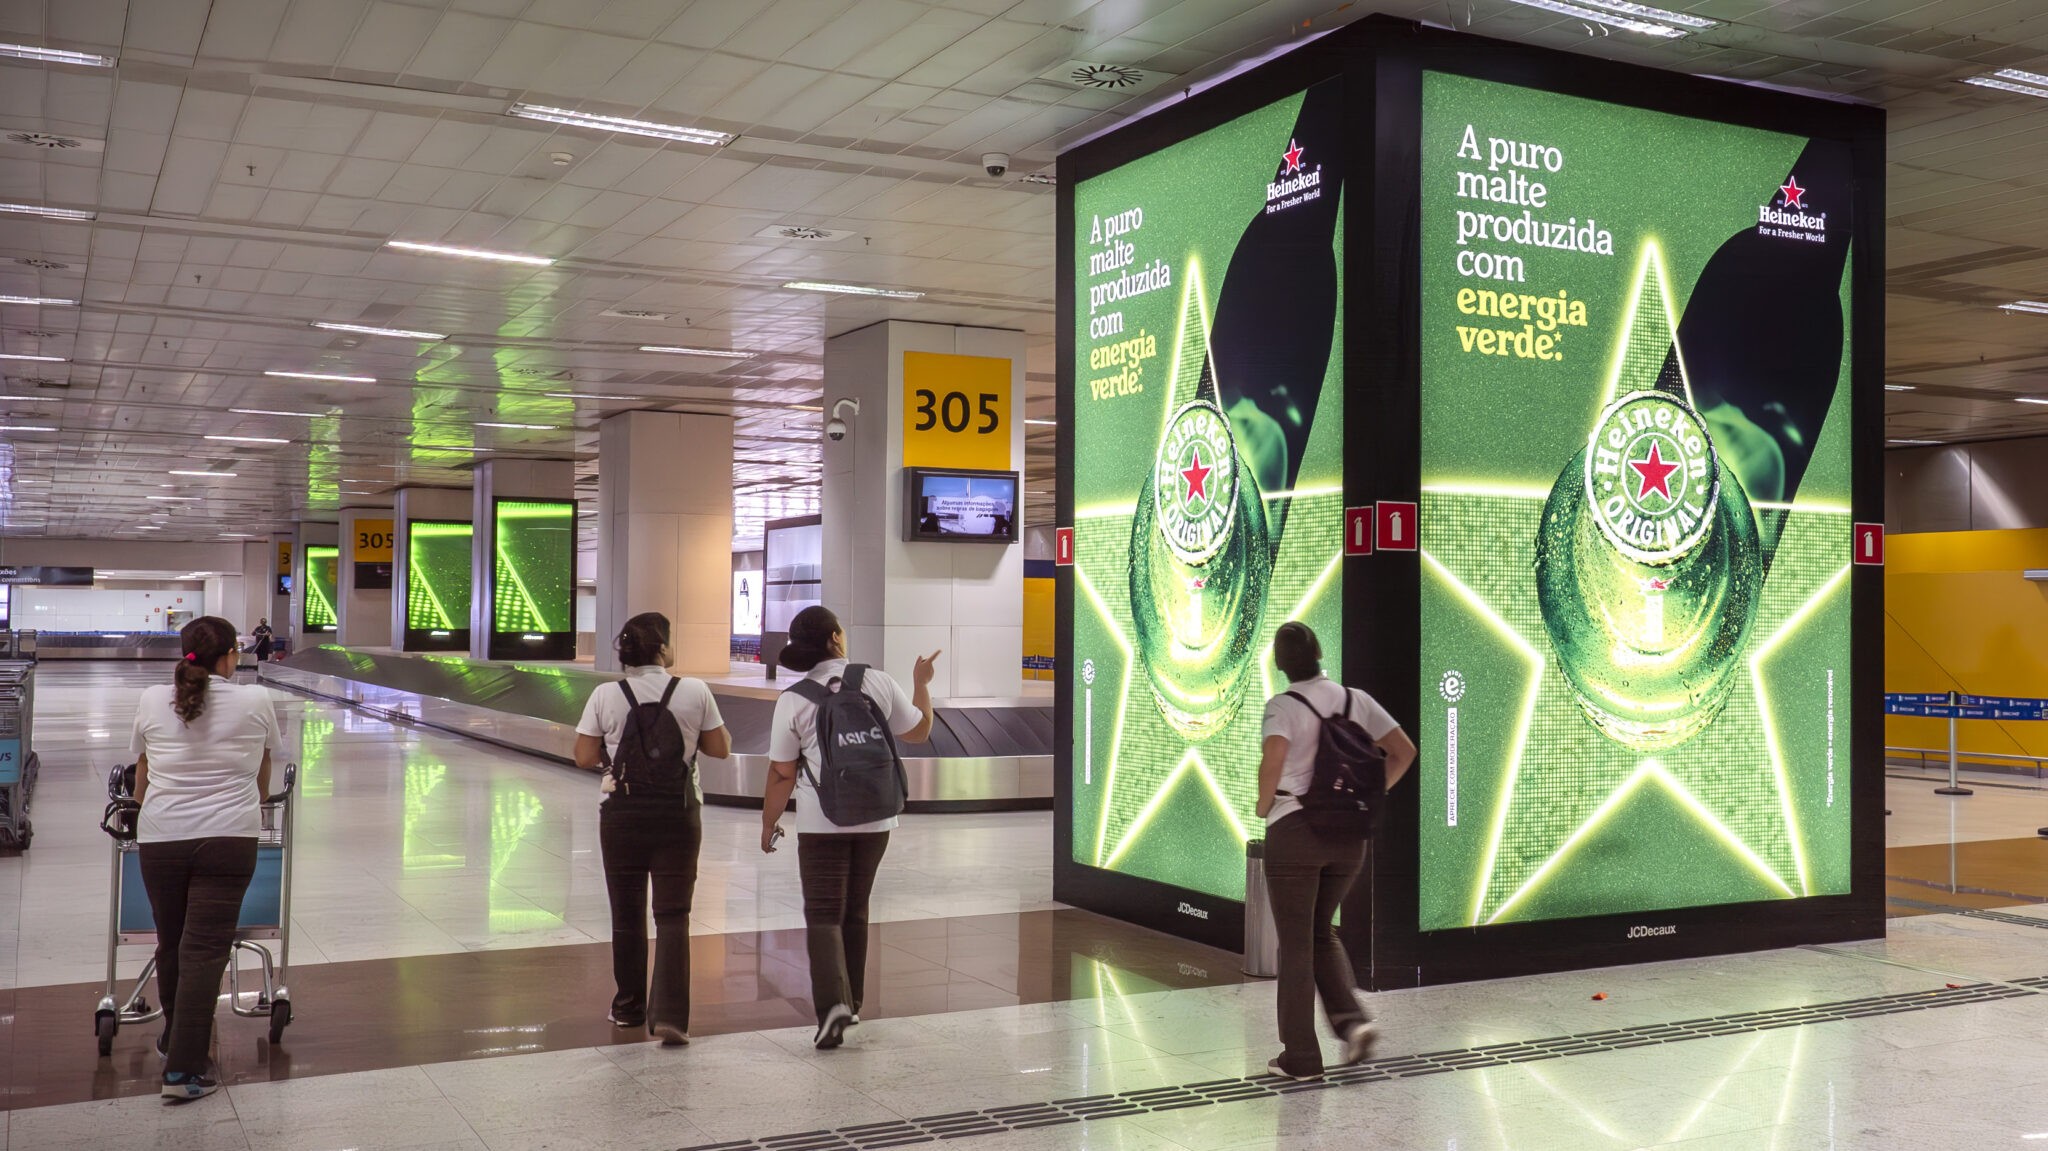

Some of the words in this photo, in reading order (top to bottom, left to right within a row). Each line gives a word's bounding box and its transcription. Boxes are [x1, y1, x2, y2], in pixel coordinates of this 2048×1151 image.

[1457, 124, 1482, 160] A
[1488, 137, 1563, 172] puro
[1456, 170, 1547, 208] malte
[1089, 214, 1102, 244] A
[1104, 207, 1143, 247] puro
[1457, 210, 1614, 256] produzida
[1759, 226, 1770, 235] For
[1778, 229, 1804, 240] Fresher
[1805, 232, 1825, 243] World
[1089, 240, 1134, 276] malte
[1457, 249, 1525, 282] com
[1089, 259, 1171, 315] produzida
[1090, 311, 1124, 339] com
[1457, 287, 1588, 331] energia
[1090, 328, 1157, 370] energia
[915, 389, 999, 434] 305
[1595, 407, 1707, 479] Heineken
[360, 532, 393, 549] 305
[1166, 501, 1228, 546] ORIGINAL
[1604, 495, 1703, 549] ORIGINAL
[1178, 902, 1208, 919] JCDecaux
[1627, 925, 1676, 938] JCDecaux
